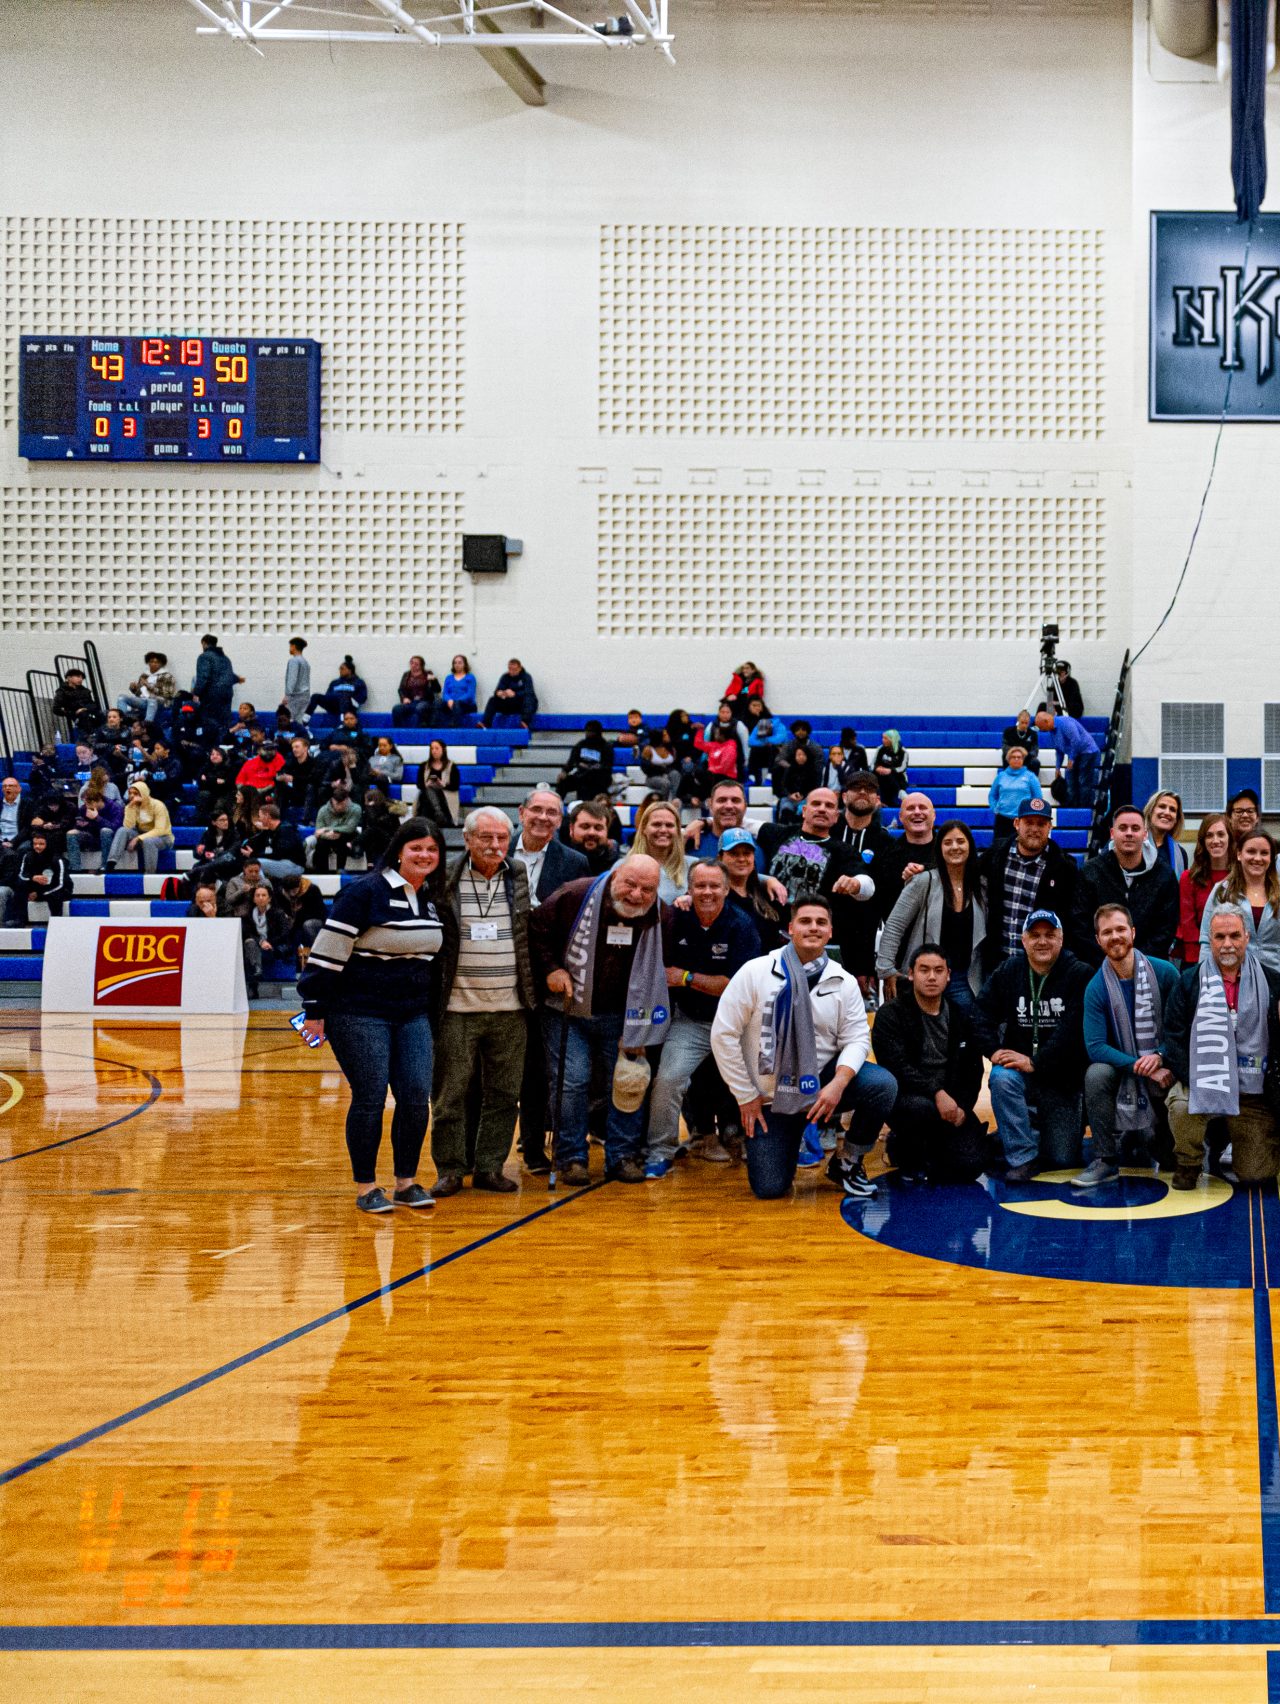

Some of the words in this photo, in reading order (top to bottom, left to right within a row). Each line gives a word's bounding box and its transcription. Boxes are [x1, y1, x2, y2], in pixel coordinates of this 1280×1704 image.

[91, 340, 119, 352] Home
[141, 339, 203, 366] 12:19
[211, 340, 247, 354] Guests
[91, 354, 124, 381] 43
[215, 356, 248, 383] 50
[150, 382, 183, 395] period
[193, 377, 205, 397] 3
[88, 400, 112, 412] fouls
[150, 400, 183, 413] player
[221, 402, 245, 414] fouls
[95, 416, 109, 437] 0
[123, 417, 136, 438] 3
[198, 418, 211, 438] 3
[228, 418, 242, 439] 0
[90, 443, 110, 453] won
[153, 444, 179, 455] game
[223, 445, 242, 454] won
[102, 933, 180, 963] CIBC
[1196, 974, 1231, 1094] ALUMNI
[801, 1080, 816, 1090] nc
